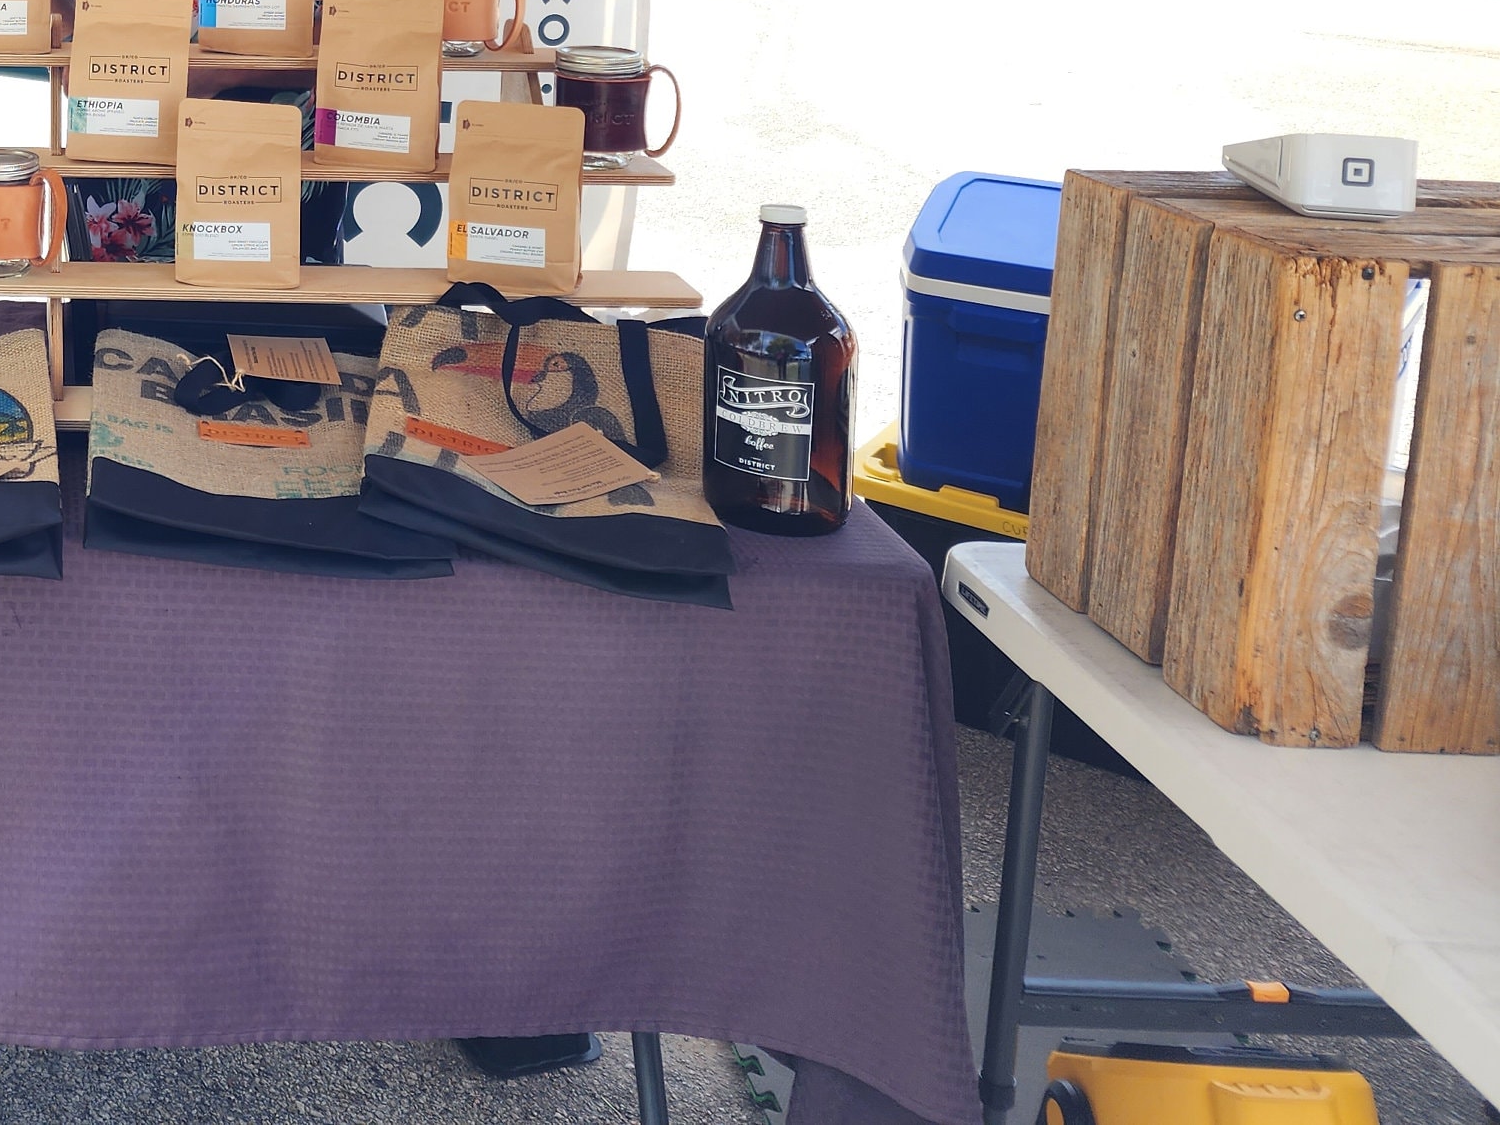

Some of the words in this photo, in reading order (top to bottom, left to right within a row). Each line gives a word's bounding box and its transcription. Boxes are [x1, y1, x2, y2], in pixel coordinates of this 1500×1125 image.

[91, 63, 168, 76] DISTRICT
[337, 70, 415, 84] DISTRICT
[76, 100, 123, 110] ETHIOPIA
[326, 112, 381, 125] COLOMBIA
[198, 184, 279, 196] DISTRICT
[472, 186, 555, 203] DISTRICT
[182, 223, 243, 234] KNOCKBOX
[456, 224, 467, 233] EL
[470, 226, 529, 239] SALVADOR
[729, 389, 802, 404] NITRO
[204, 427, 304, 443] DISTRICT
[411, 426, 501, 453] DISTRIC
[738, 457, 776, 472] DISTRICT
